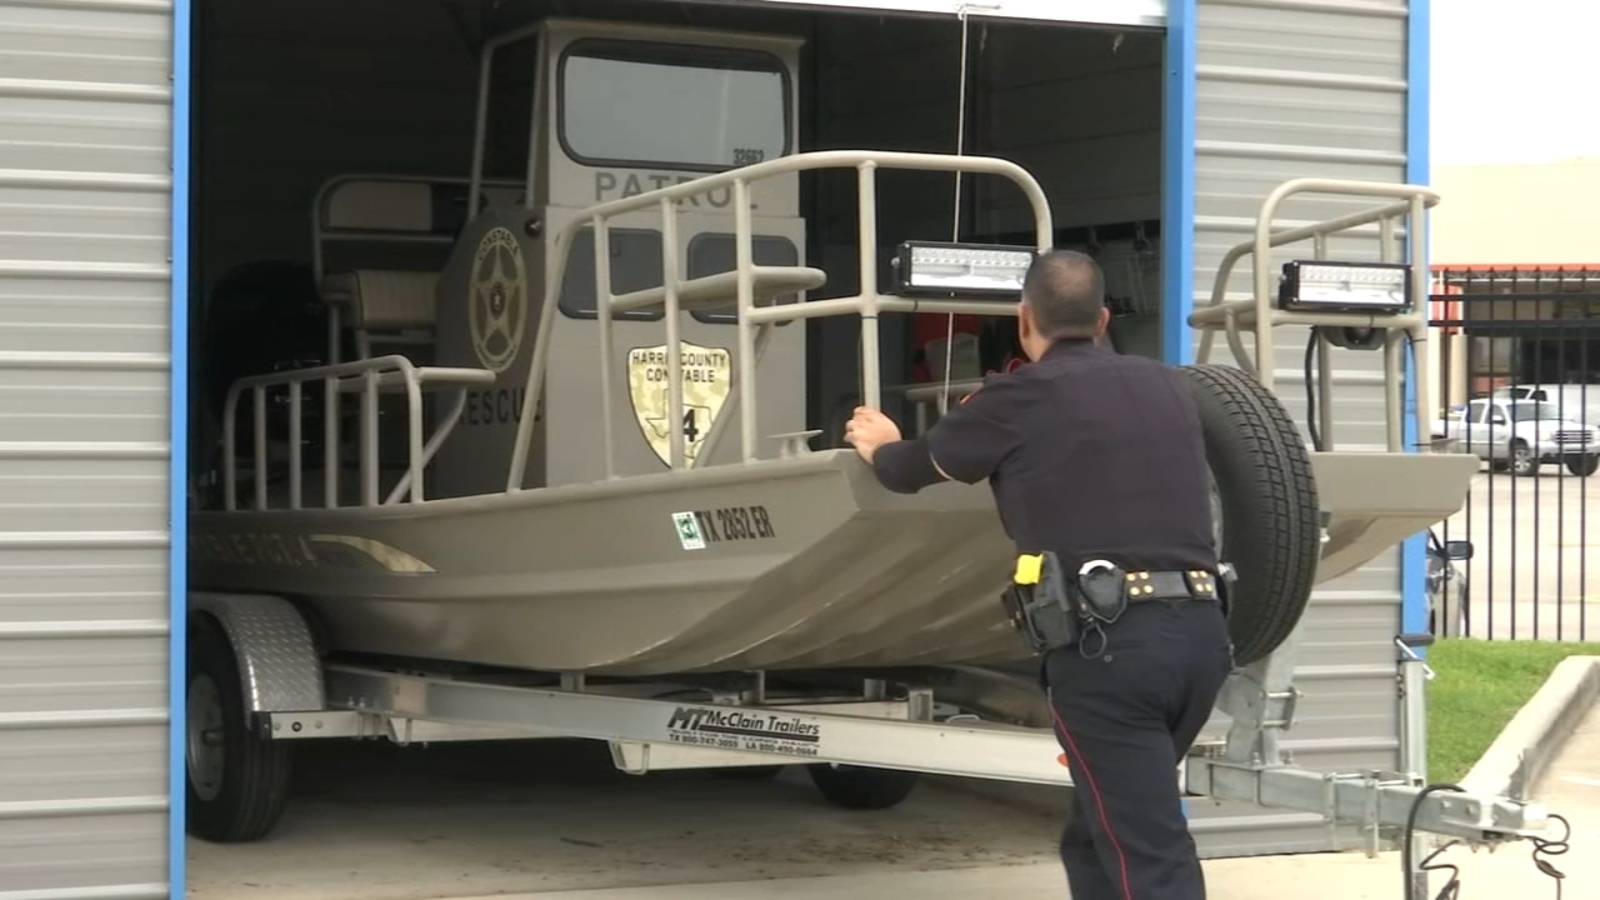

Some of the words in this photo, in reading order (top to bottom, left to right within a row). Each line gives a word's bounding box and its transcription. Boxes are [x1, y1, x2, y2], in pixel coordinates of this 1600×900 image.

[595, 172, 758, 210] PATRO
[633, 351, 669, 366] HARRI
[680, 353, 727, 367] COUNTY
[646, 368, 715, 383] CONTABLE
[460, 388, 542, 426] ESCU
[681, 408, 699, 442] 4
[694, 510, 722, 542] TX
[716, 507, 757, 541] 2852
[749, 505, 776, 538] ER
[705, 710, 765, 730] McClain
[767, 715, 820, 735] Trailers
